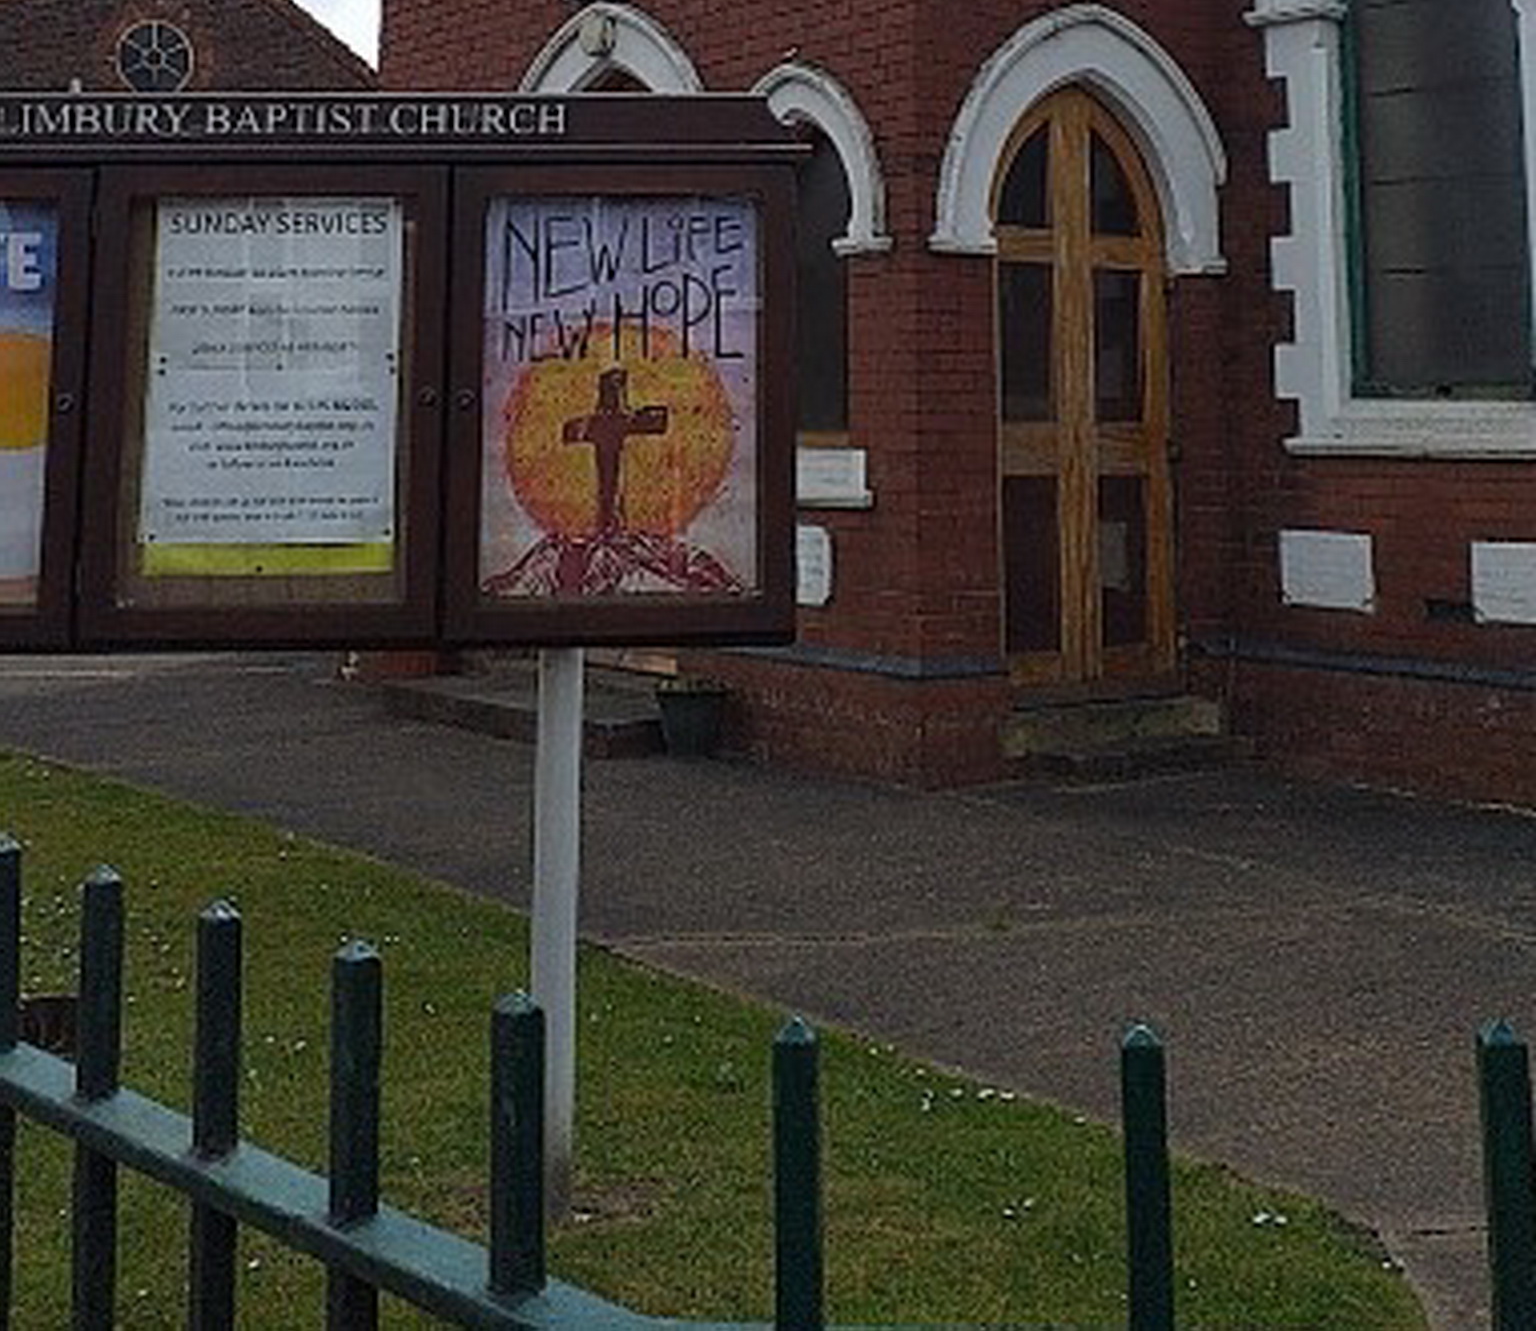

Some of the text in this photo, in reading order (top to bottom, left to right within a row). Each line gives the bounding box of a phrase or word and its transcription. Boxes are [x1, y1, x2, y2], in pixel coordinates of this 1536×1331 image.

[205, 103, 378, 135] BAPTIST
[388, 103, 567, 135] CHURCH
[169, 211, 388, 235] SUNDAY SERVICES
[501, 214, 630, 314] NEW
[501, 298, 598, 363] NEW
